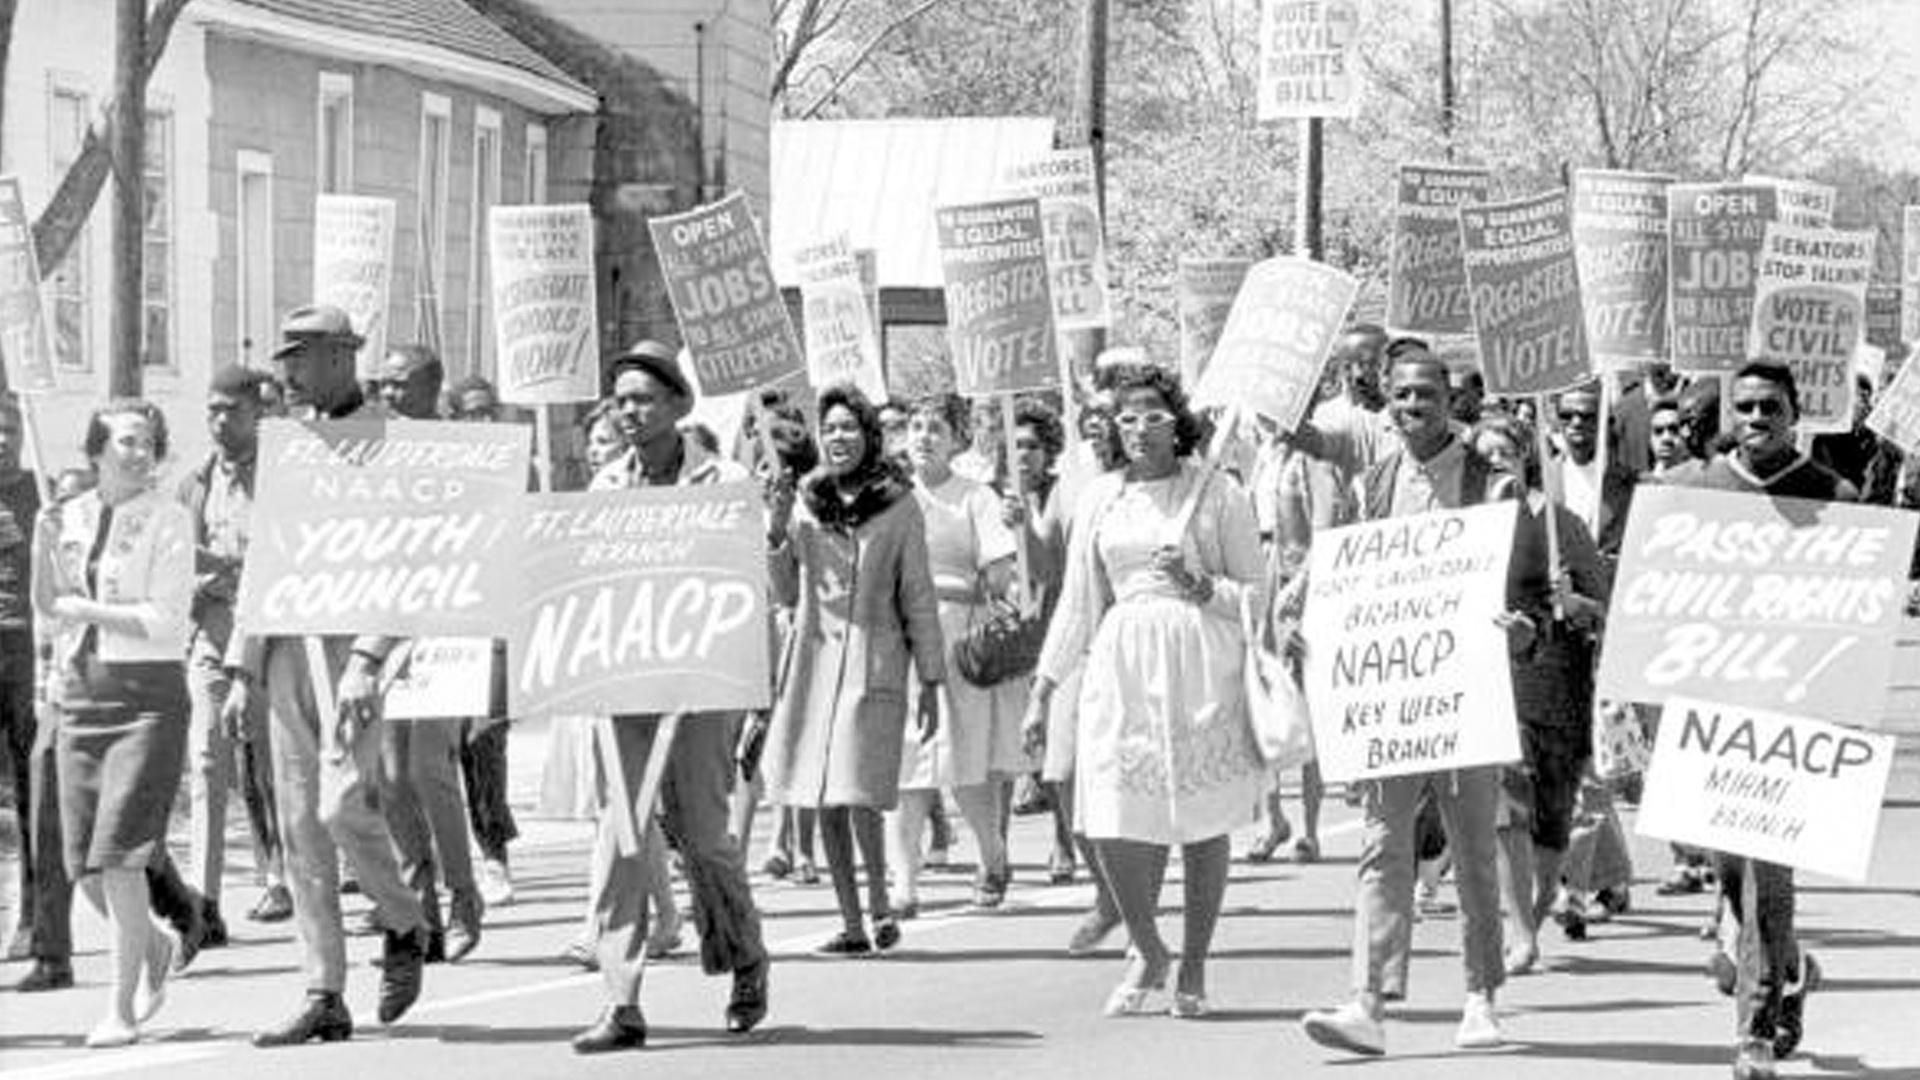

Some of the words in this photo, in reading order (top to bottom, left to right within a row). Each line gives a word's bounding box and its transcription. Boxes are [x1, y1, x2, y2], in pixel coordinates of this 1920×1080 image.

[1271, 27, 1343, 52] CIVIL
[1266, 53, 1344, 76] RIGHTS
[1275, 80, 1335, 102] BILL
[1695, 193, 1758, 215] OPEN
[671, 210, 736, 246] OPEN
[1484, 219, 1560, 246] EQUAL
[681, 256, 772, 320] JOBS
[1677, 250, 1751, 289] JOB
[1773, 293, 1833, 325] VOTE
[1768, 327, 1848, 355] CIVIL
[1790, 359, 1846, 387] GHTS
[310, 471, 465, 503] NAACP
[295, 511, 485, 565] YOUTH
[1333, 515, 1466, 572] NAACP
[1641, 511, 1788, 567] PASS
[1782, 523, 1892, 566] THE
[262, 558, 486, 618] COUNCIL
[1620, 568, 1742, 620] CIVIL
[1740, 571, 1896, 625] RIGHTS
[1344, 587, 1464, 633] BRANCH
[519, 575, 757, 693] NAACP
[1331, 628, 1456, 689] NAACP
[1341, 700, 1387, 734] KEY
[1399, 690, 1465, 726] WEST
[1367, 730, 1459, 770] BRANCH
[1678, 708, 1874, 779] NAACP
[1705, 764, 1792, 806] MIAMI
